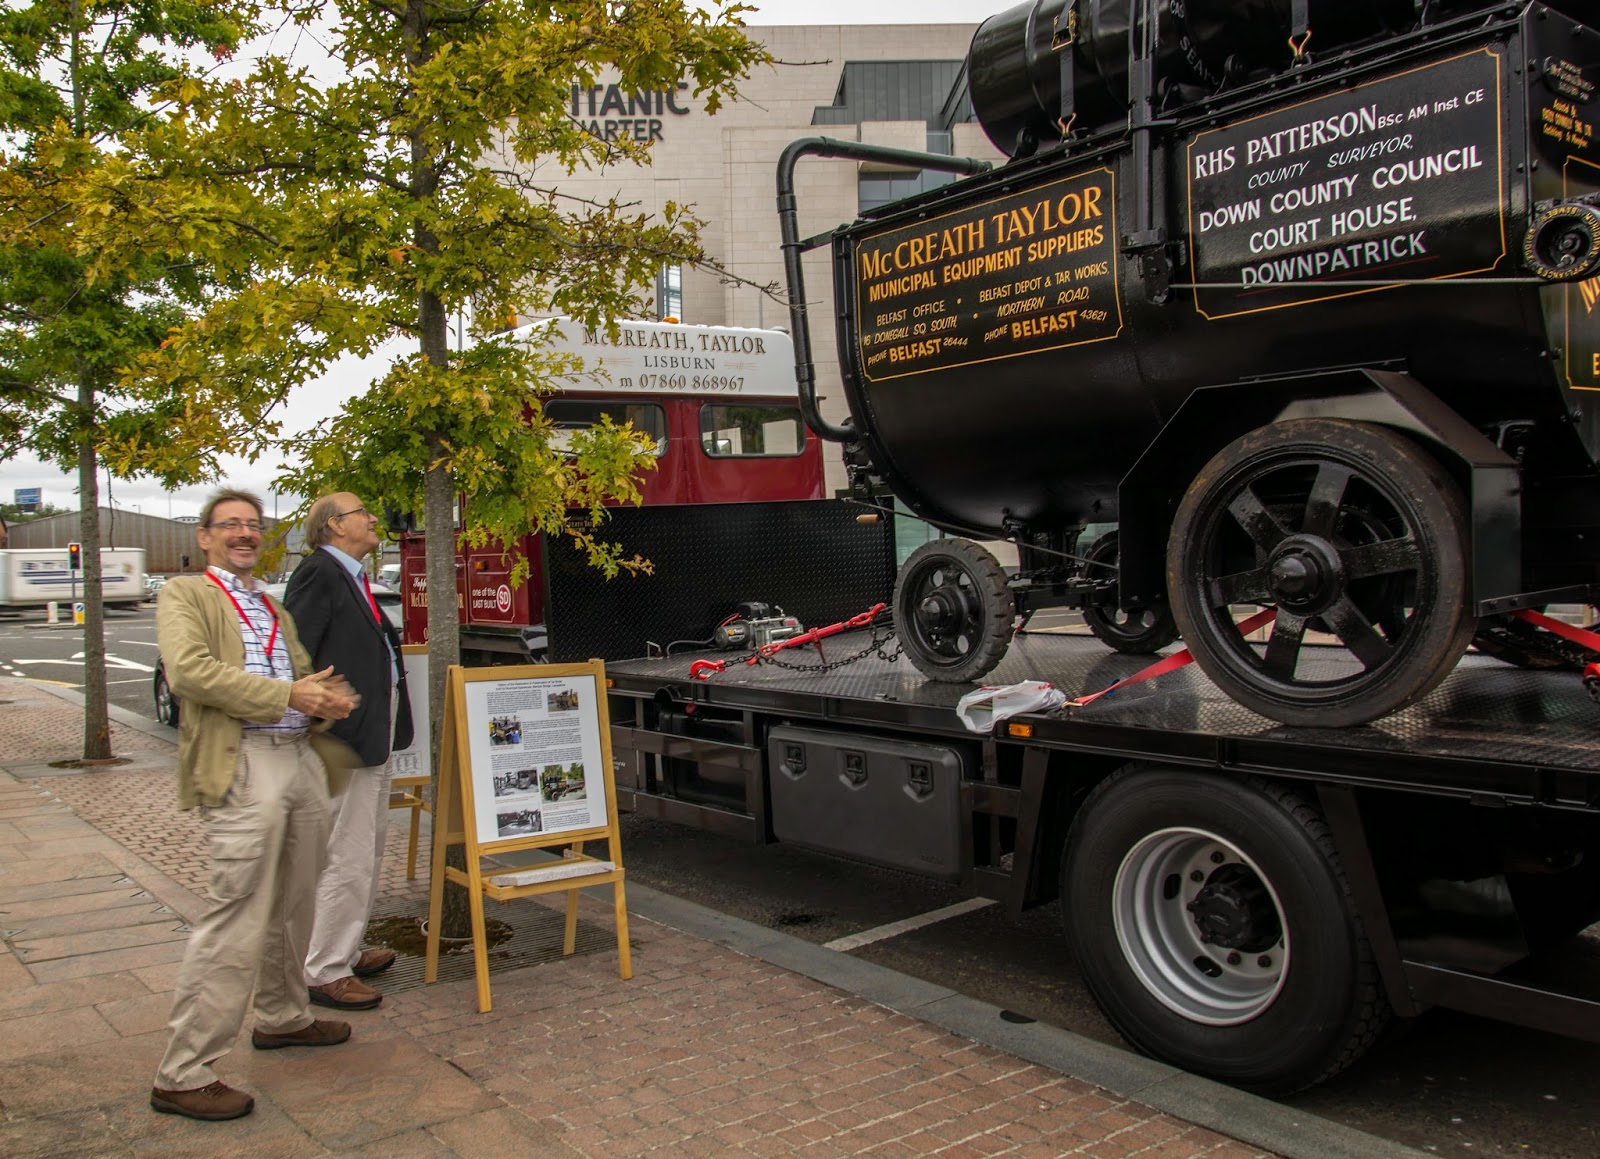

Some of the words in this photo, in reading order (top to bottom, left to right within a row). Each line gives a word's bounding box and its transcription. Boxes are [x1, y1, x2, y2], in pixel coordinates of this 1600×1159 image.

[571, 82, 690, 116] ITANIC
[570, 119, 664, 141] ARTER
[1194, 146, 1236, 180] RHS
[1247, 104, 1378, 165] PATTERSON
[1407, 104, 1428, 121] AM
[1434, 96, 1459, 114] Inst
[1464, 88, 1484, 104] CE
[1199, 199, 1261, 233] DOWN
[1270, 174, 1360, 214] COUNTY
[1371, 145, 1482, 190] COUNCIL
[1248, 160, 1310, 190] COUNTY
[991, 185, 1103, 244] TAYLOR
[1249, 218, 1321, 254] COURT
[1331, 196, 1418, 237] HOUSE,
[868, 269, 937, 303] MUNICIPAL
[943, 246, 1023, 284] EQUIPMENT
[1027, 224, 1104, 263] SUPPLIERS
[1240, 231, 1427, 290] DOWNPATRICK
[979, 284, 1013, 303] BELFAST
[1014, 277, 1043, 295] DEPOT
[1044, 276, 1052, 288] &
[1054, 270, 1071, 285] TAR
[876, 309, 908, 327] BELFAST
[996, 296, 1046, 318] NORTHERN
[873, 326, 909, 345] DONEGALL
[983, 324, 1008, 343] PHONE
[1011, 310, 1078, 339] BELFAST
[698, 334, 767, 355] TAYLOR
[867, 349, 888, 367] PHONE
[889, 338, 942, 363] BELFAST
[643, 356, 716, 370] LISBURN
[620, 376, 633, 389] m
[639, 373, 687, 390] 07860
[691, 376, 745, 392] 868967
